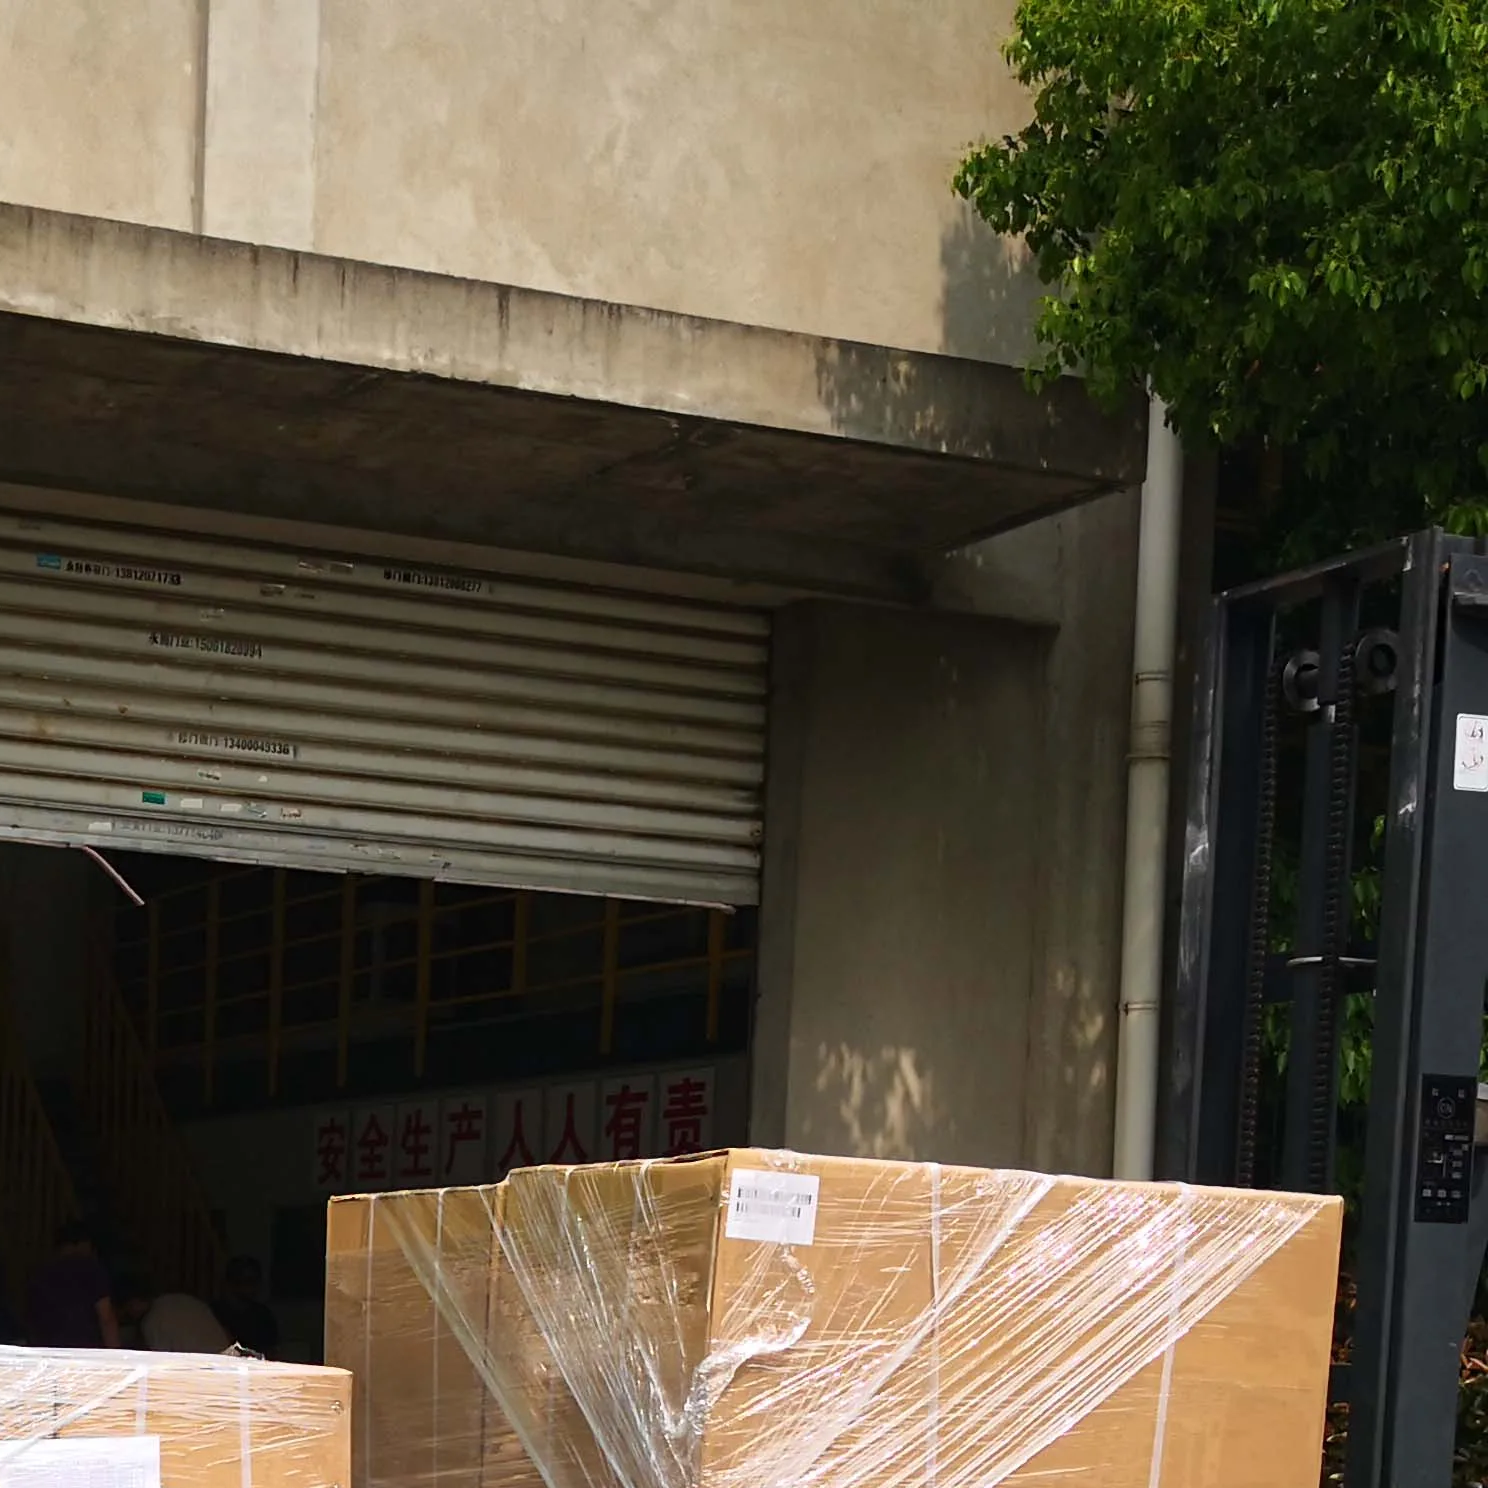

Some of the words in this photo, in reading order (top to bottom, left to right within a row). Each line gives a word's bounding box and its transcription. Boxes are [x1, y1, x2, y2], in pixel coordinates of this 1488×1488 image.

[316, 1076, 709, 1185] 安全生产人人有责
